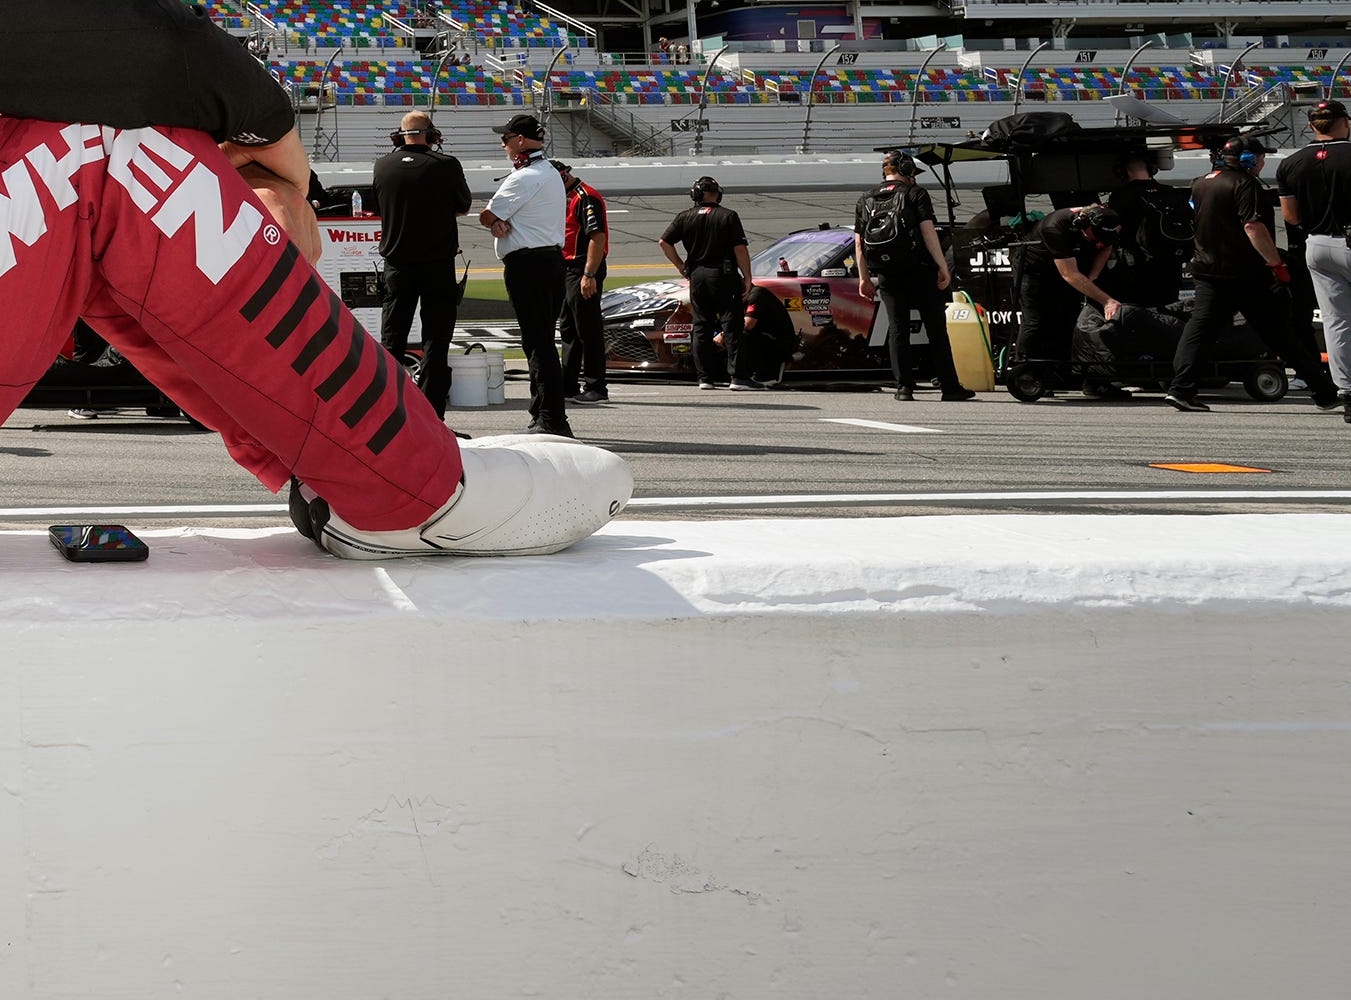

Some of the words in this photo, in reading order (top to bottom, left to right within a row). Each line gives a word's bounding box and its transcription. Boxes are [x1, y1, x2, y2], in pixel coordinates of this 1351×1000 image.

[842, 53, 854, 64] 152
[1079, 51, 1091, 62] 151
[952, 309, 970, 321] 19
